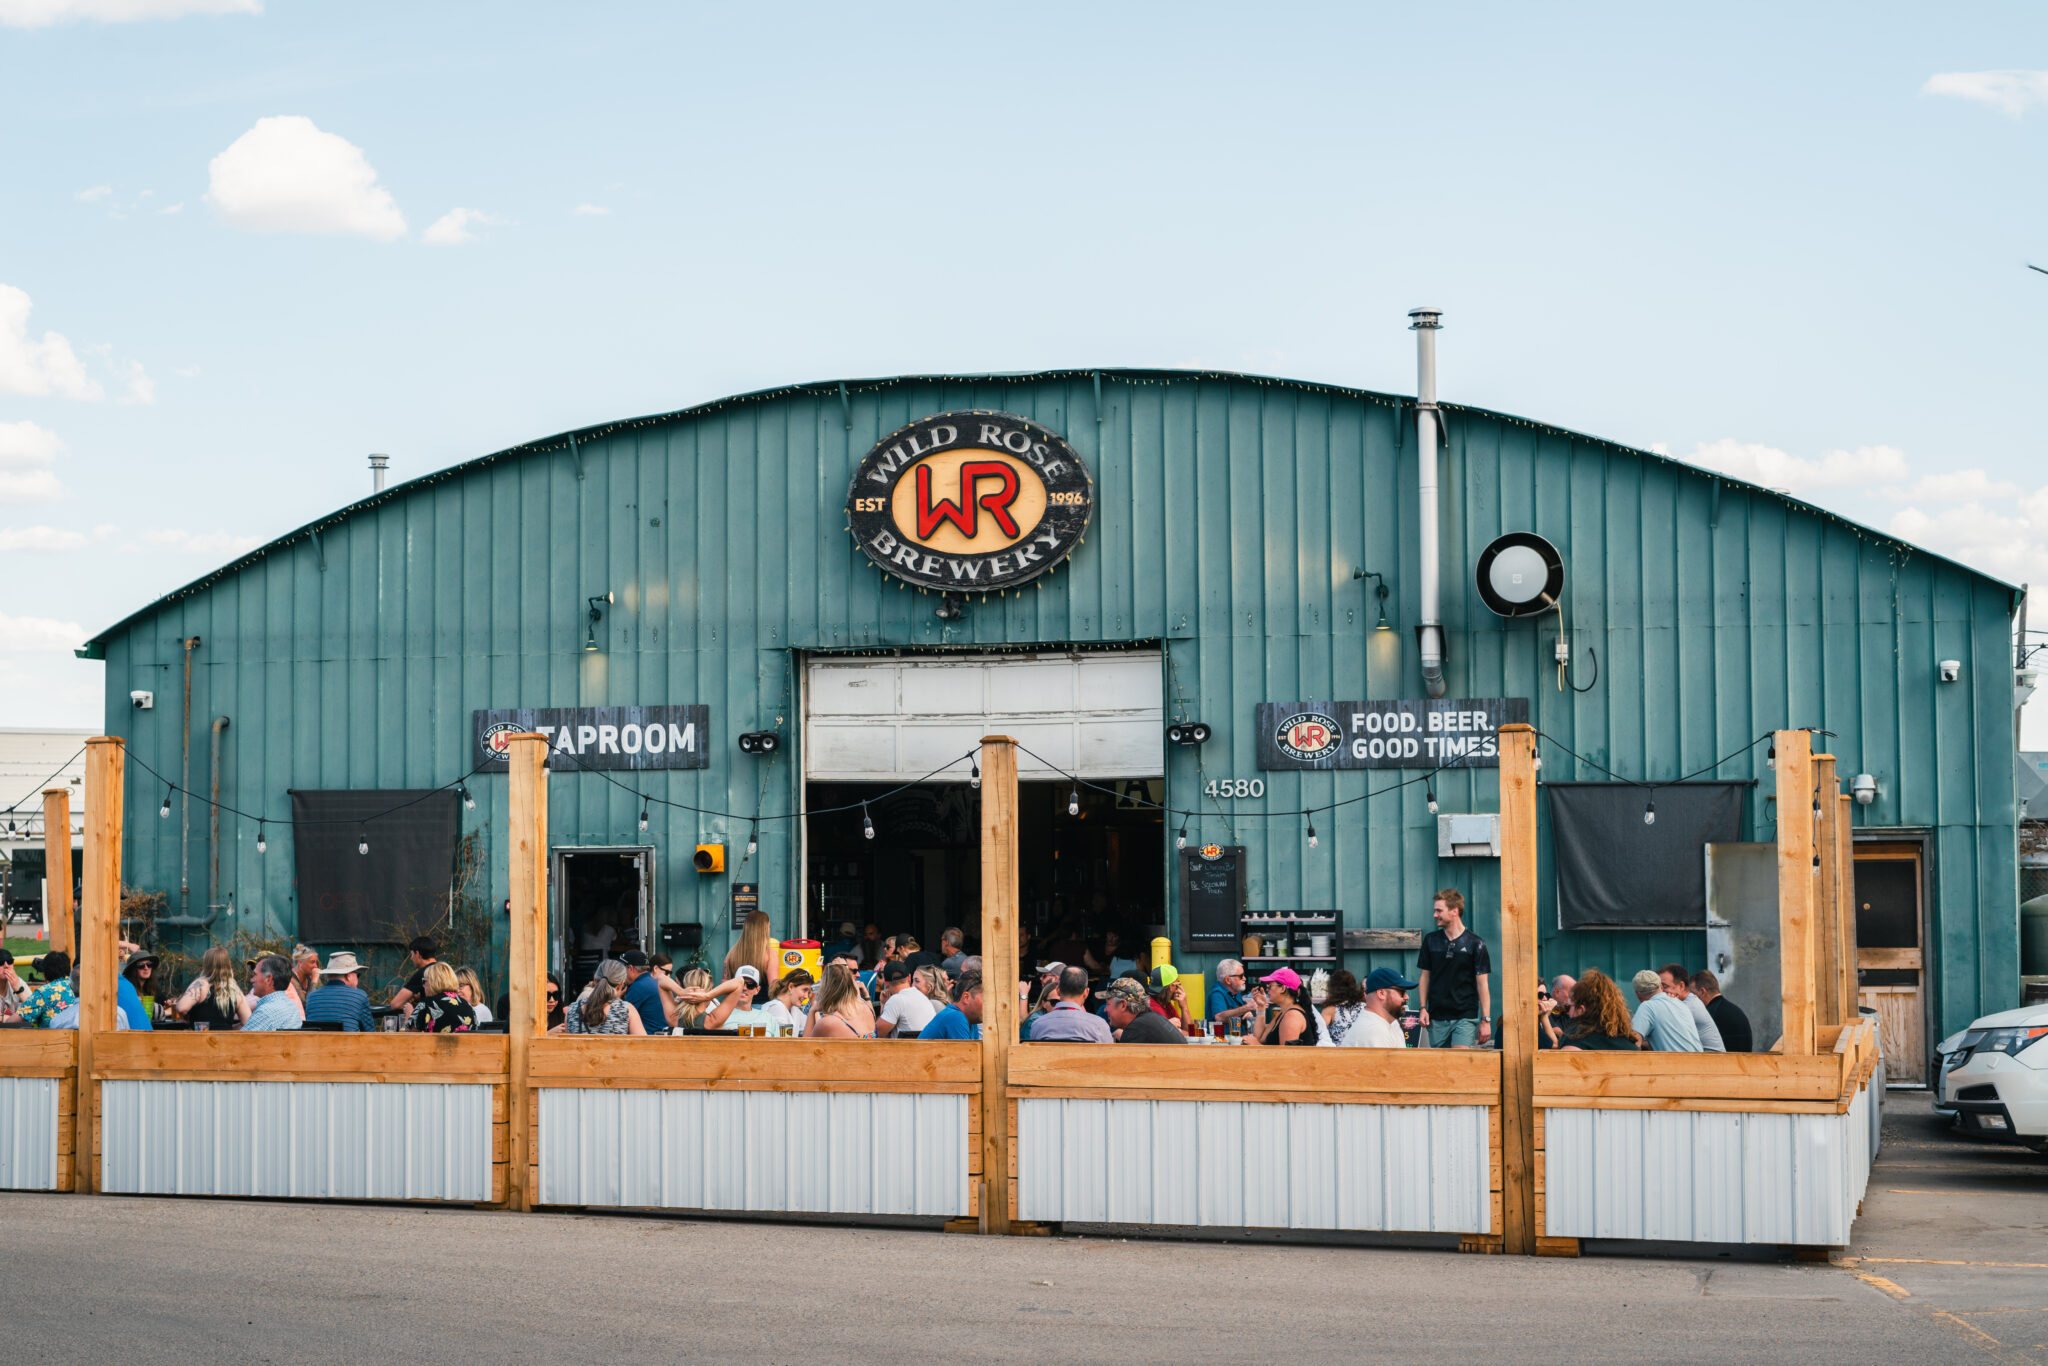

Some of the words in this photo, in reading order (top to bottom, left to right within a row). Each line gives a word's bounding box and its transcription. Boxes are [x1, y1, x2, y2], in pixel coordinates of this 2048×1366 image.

[868, 424, 958, 485] WILD
[977, 423, 1068, 485] ROSE
[855, 498, 886, 512] EST
[915, 460, 1021, 540] WR
[1049, 492, 1084, 506] 1996
[870, 528, 1062, 580] BREWERY
[485, 725, 504, 739] WILD
[507, 724, 523, 734] ROS
[1280, 715, 1307, 732] WILD
[1311, 715, 1337, 733] ROSE
[1352, 712, 1423, 733] FOOD.
[1428, 711, 1495, 732] BEER.
[495, 732, 514, 751] W
[1295, 725, 1325, 747] WR
[1282, 742, 1336, 759] BREWERY
[1352, 737, 1419, 759] GOOD
[1204, 778, 1265, 798] 4580
